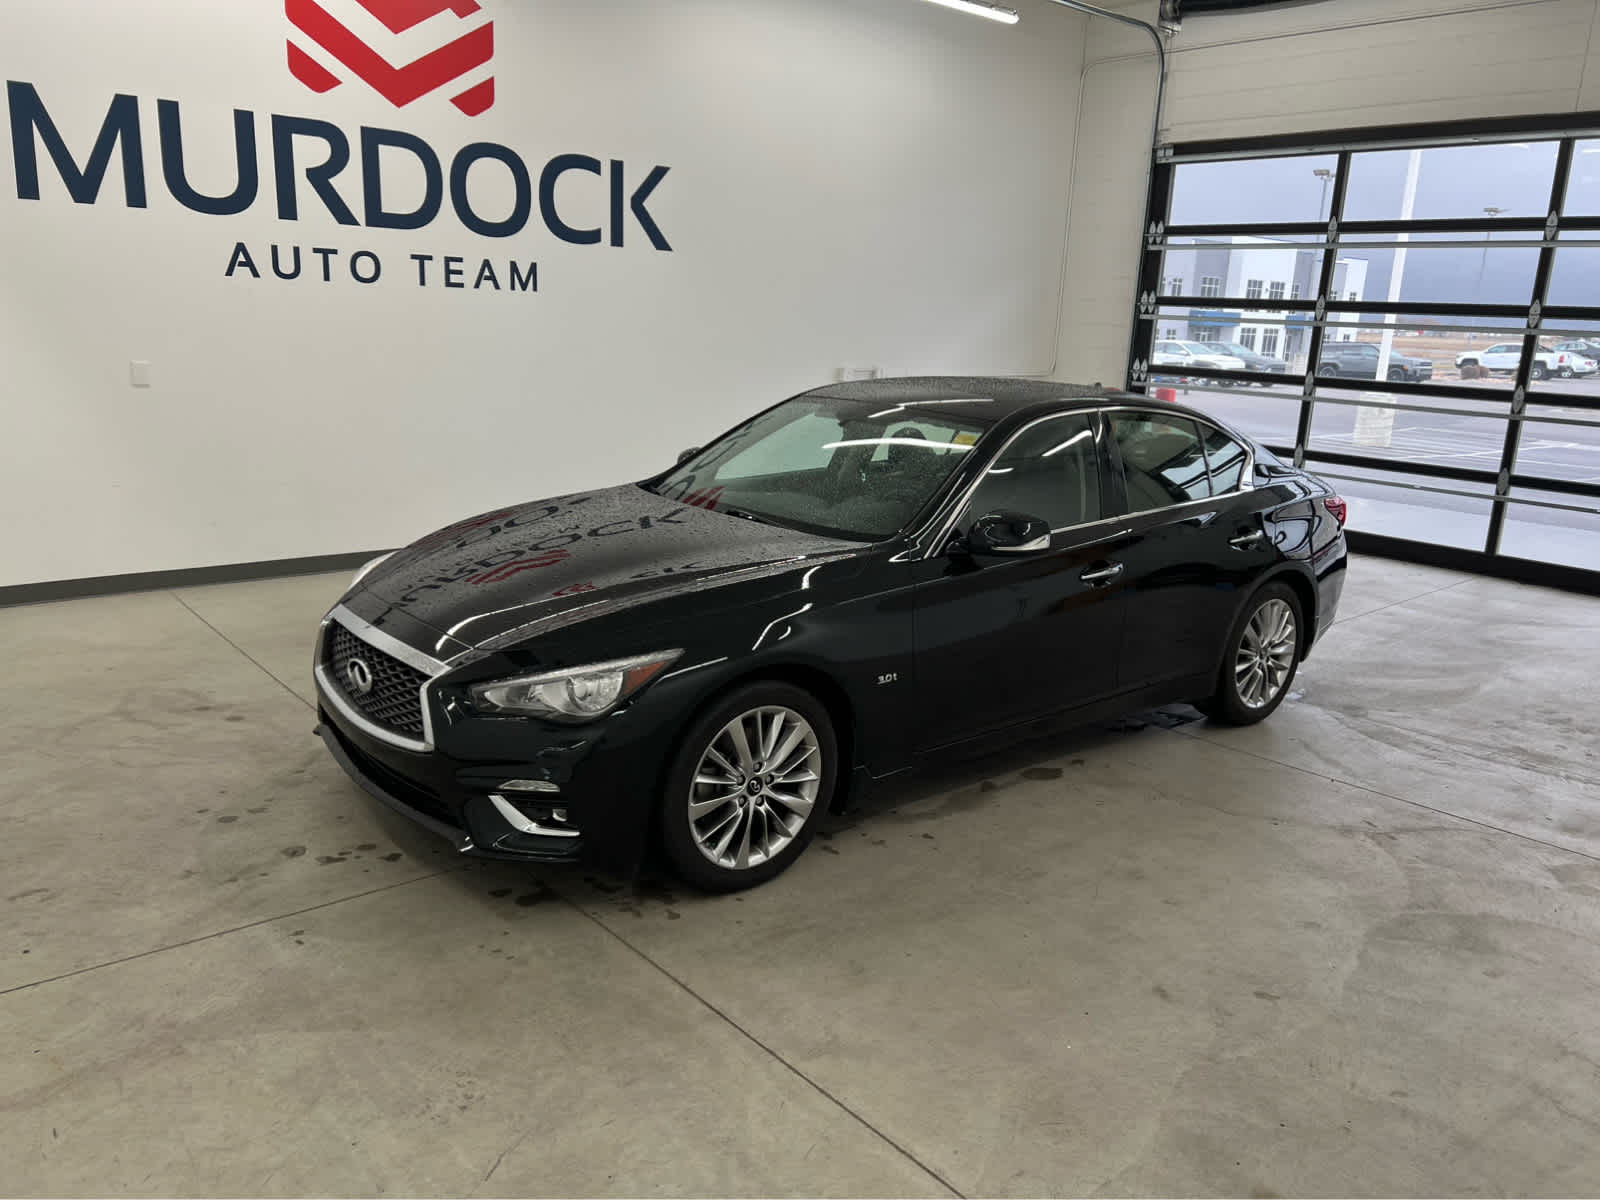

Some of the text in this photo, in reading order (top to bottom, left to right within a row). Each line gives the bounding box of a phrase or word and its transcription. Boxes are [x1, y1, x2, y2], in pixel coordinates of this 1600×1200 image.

[6, 79, 673, 252] MURDOCK
[225, 242, 539, 292] AUTO TEAM
